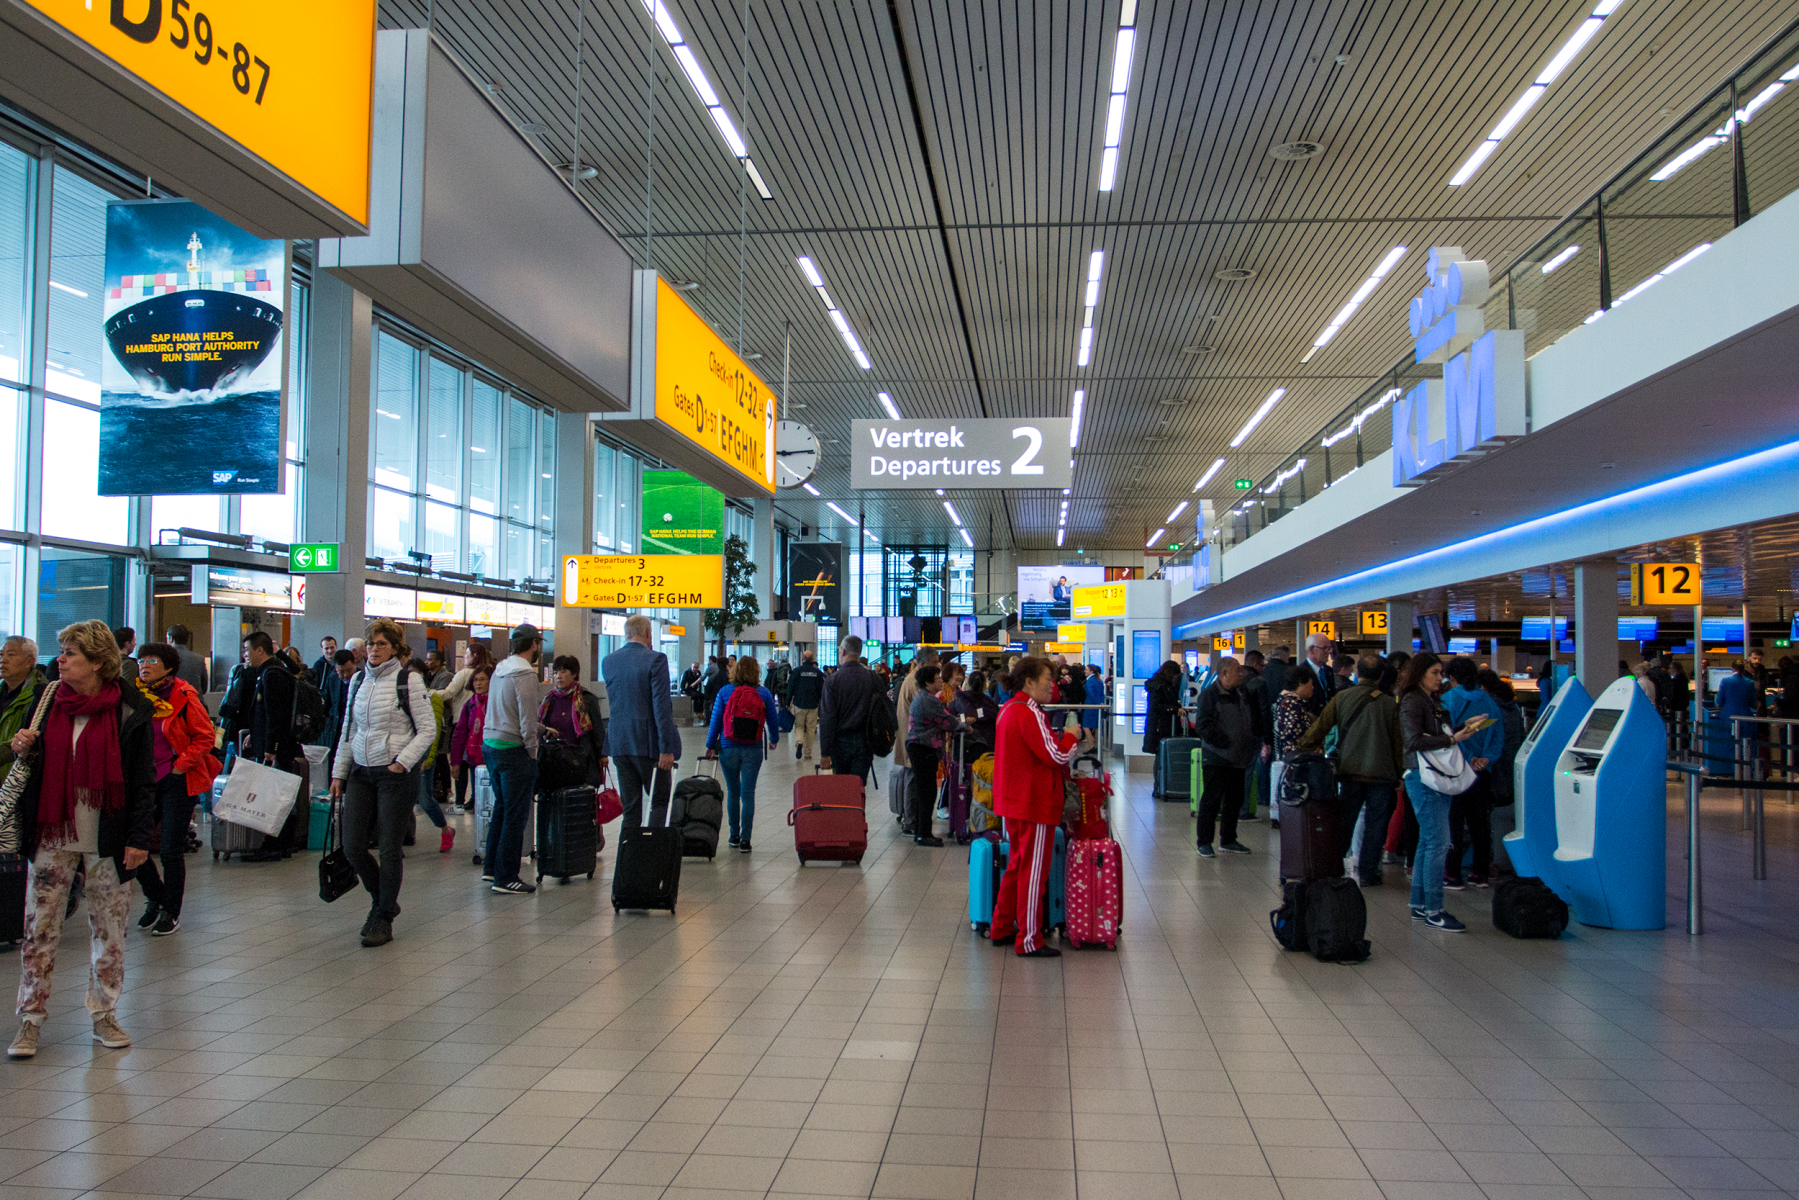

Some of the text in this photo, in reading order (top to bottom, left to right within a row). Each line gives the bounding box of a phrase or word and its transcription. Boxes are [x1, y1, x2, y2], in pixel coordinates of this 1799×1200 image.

[151, 333, 171, 343] SAP
[203, 331, 234, 341] HELPS
[125, 341, 260, 354] HAMBURG PORT AUTHORITY
[161, 352, 222, 362] RUN SIMPLE.
[709, 351, 757, 419] Check-in 12-32
[674, 385, 694, 418] Gates
[1392, 329, 1496, 489] KLM
[869, 425, 965, 448] Vertrek
[869, 426, 1045, 481] Departures 2
[213, 472, 232, 483] SAP
[594, 556, 646, 570] Departures 3
[593, 575, 665, 587] Check-in 17-32
[1651, 565, 1691, 594] 12
[593, 594, 615, 602] Gates
[617, 592, 626, 604] D
[1368, 614, 1387, 628] 13
[1313, 624, 1330, 635] 14
[1216, 638, 1228, 648] 16
